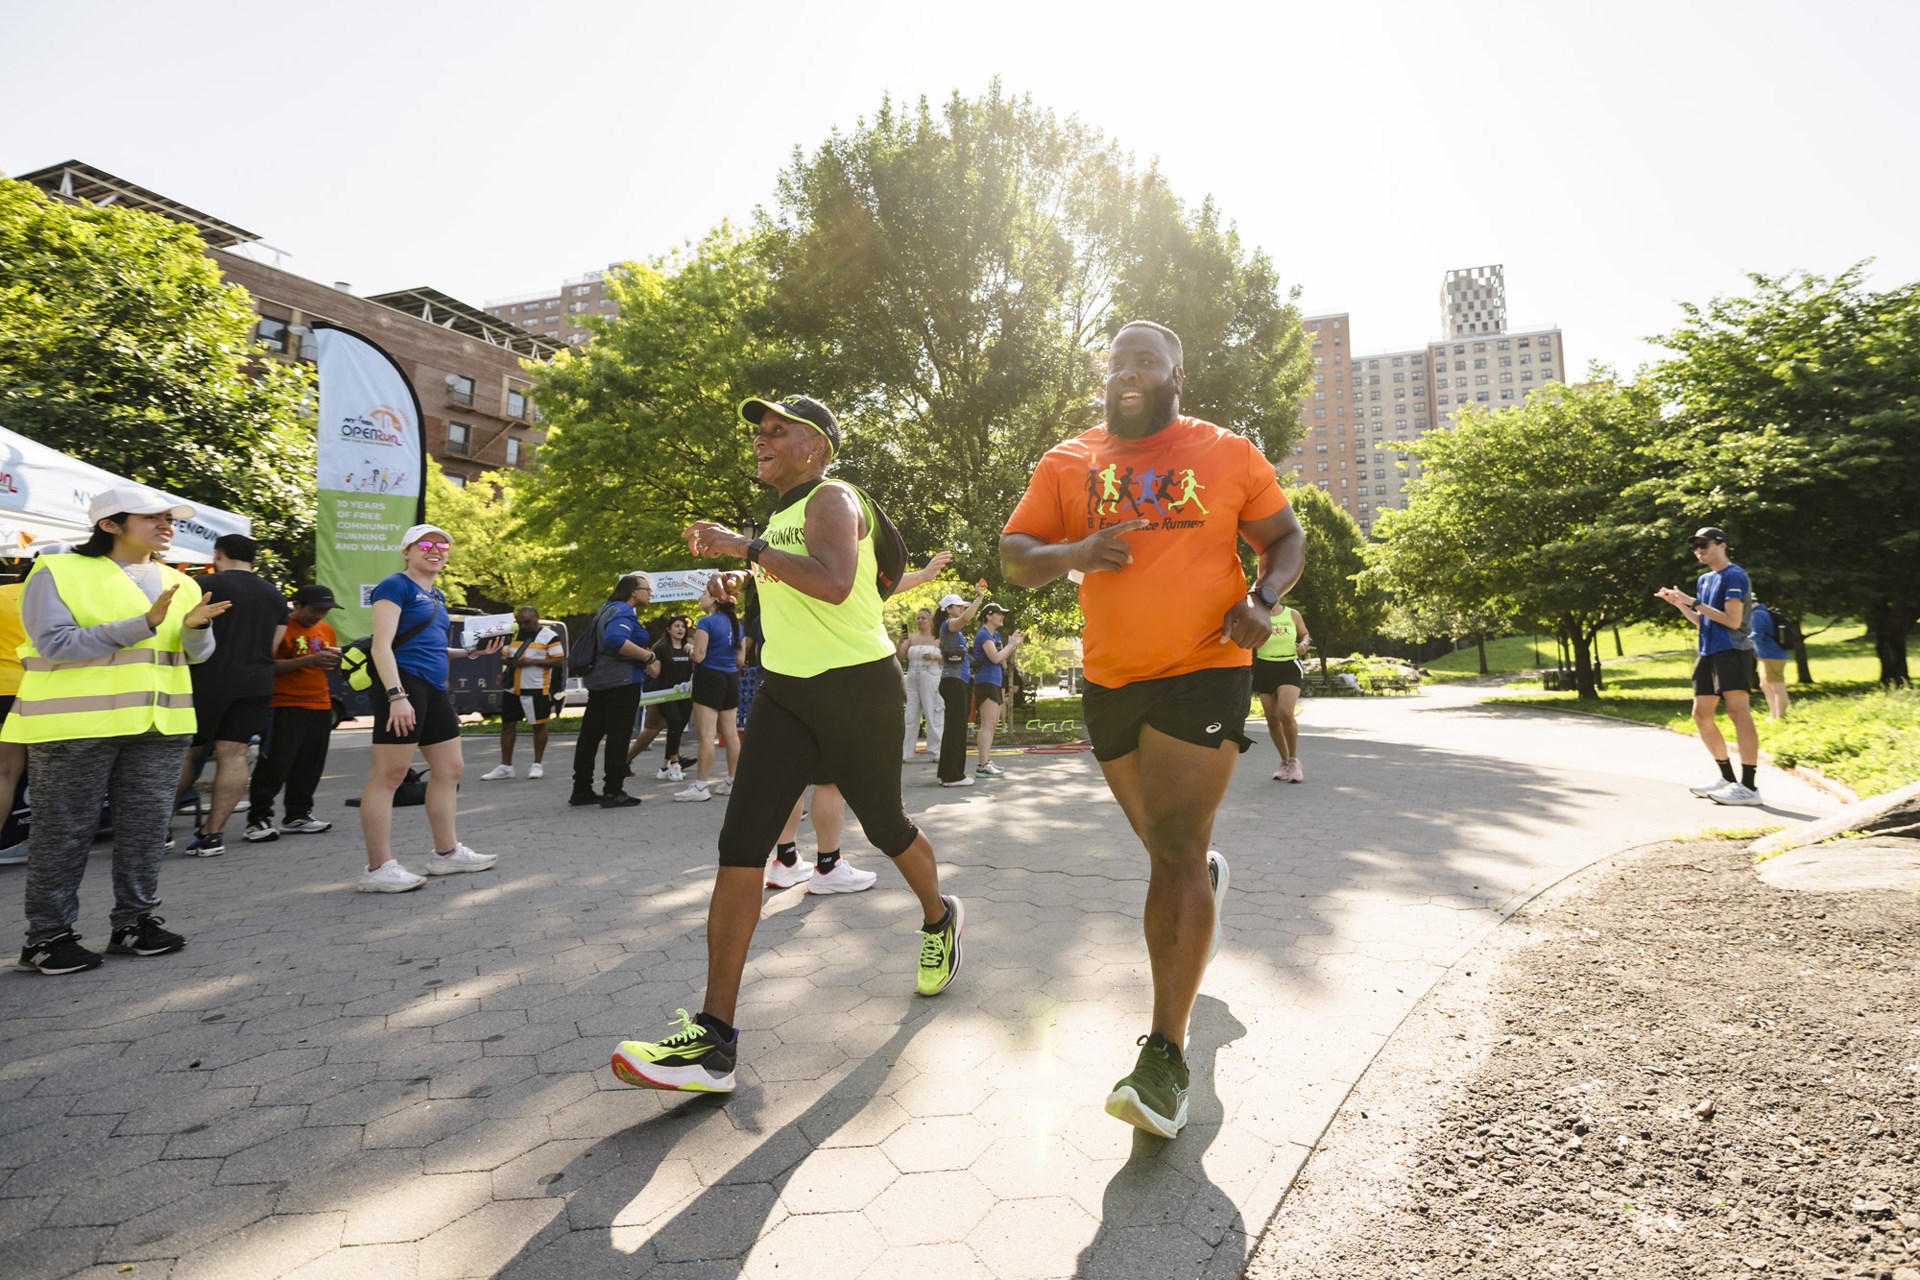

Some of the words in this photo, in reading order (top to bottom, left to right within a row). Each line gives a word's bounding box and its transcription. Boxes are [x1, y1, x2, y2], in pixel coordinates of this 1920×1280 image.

[337, 500, 348, 508] 10
[350, 501, 386, 510] YEARS
[353, 512, 381, 520] FREE
[336, 521, 401, 531] COMMUNITY
[1161, 517, 1205, 531] Runners
[336, 532, 386, 541] RUNNING
[361, 543, 402, 551] WALKI
[687, 575, 706, 587] VOLUN
